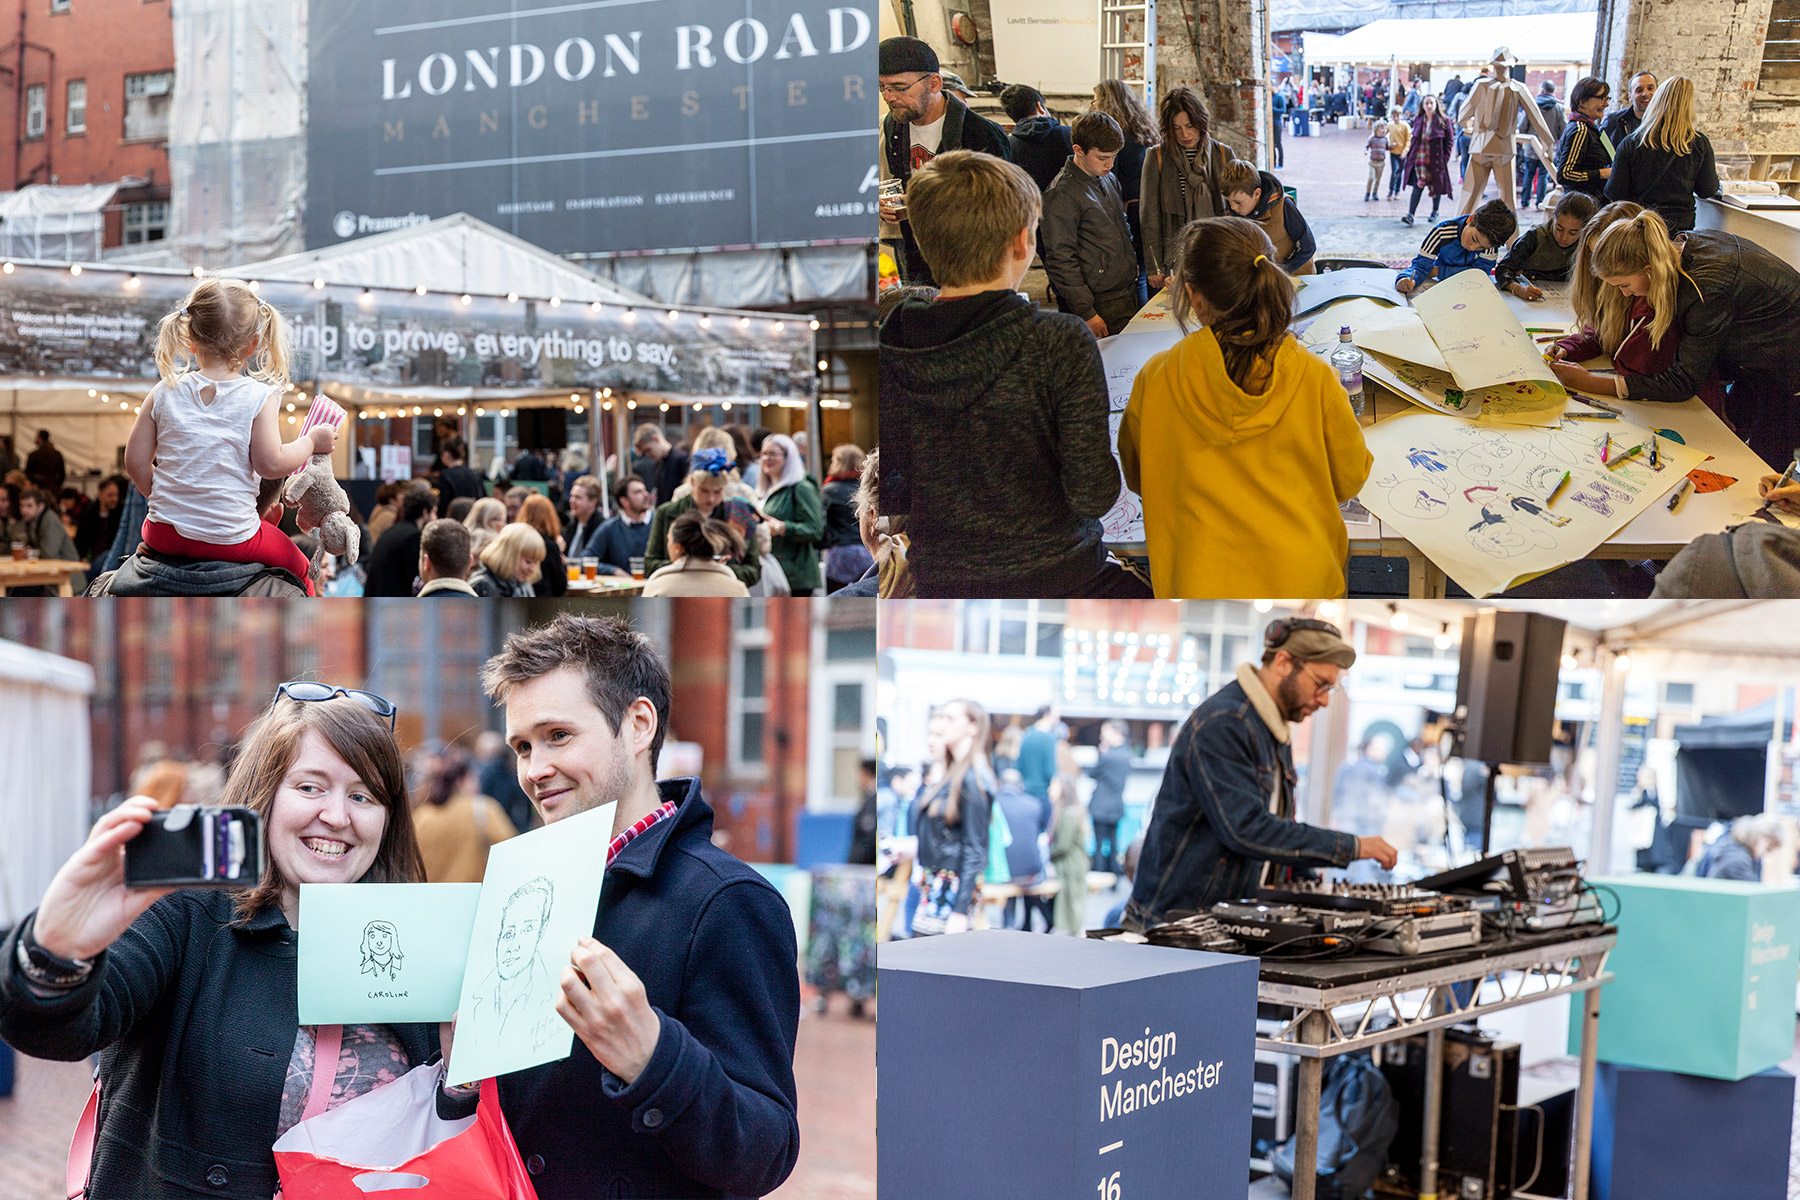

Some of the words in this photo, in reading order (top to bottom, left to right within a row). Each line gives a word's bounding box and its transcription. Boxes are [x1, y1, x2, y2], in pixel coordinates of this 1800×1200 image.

[1007, 16, 1026, 25] Levitt
[1027, 16, 1060, 25] Bernstein
[381, 31, 643, 101] LONDON
[675, 6, 872, 71] ROAD
[383, 74, 867, 143] MANCHESTER
[566, 194, 644, 211] INSPIRATION
[654, 189, 736, 205] EXPERIENCE
[815, 201, 864, 217] ALLIED
[12, 311, 54, 323] Welcome
[66, 313, 95, 326] Design
[346, 321, 376, 350] to
[383, 328, 467, 359] prove,
[474, 329, 604, 368] everything
[608, 335, 632, 362] to
[637, 341, 678, 368] say.
[1063, 627, 1201, 706] PIZZA
[1333, 917, 1365, 929] Pioneer
[367, 990, 409, 999] CAROLINE
[1101, 1026, 1177, 1076] Design
[1100, 1060, 1224, 1123] Manchester
[1097, 1171, 1121, 1200] 16
